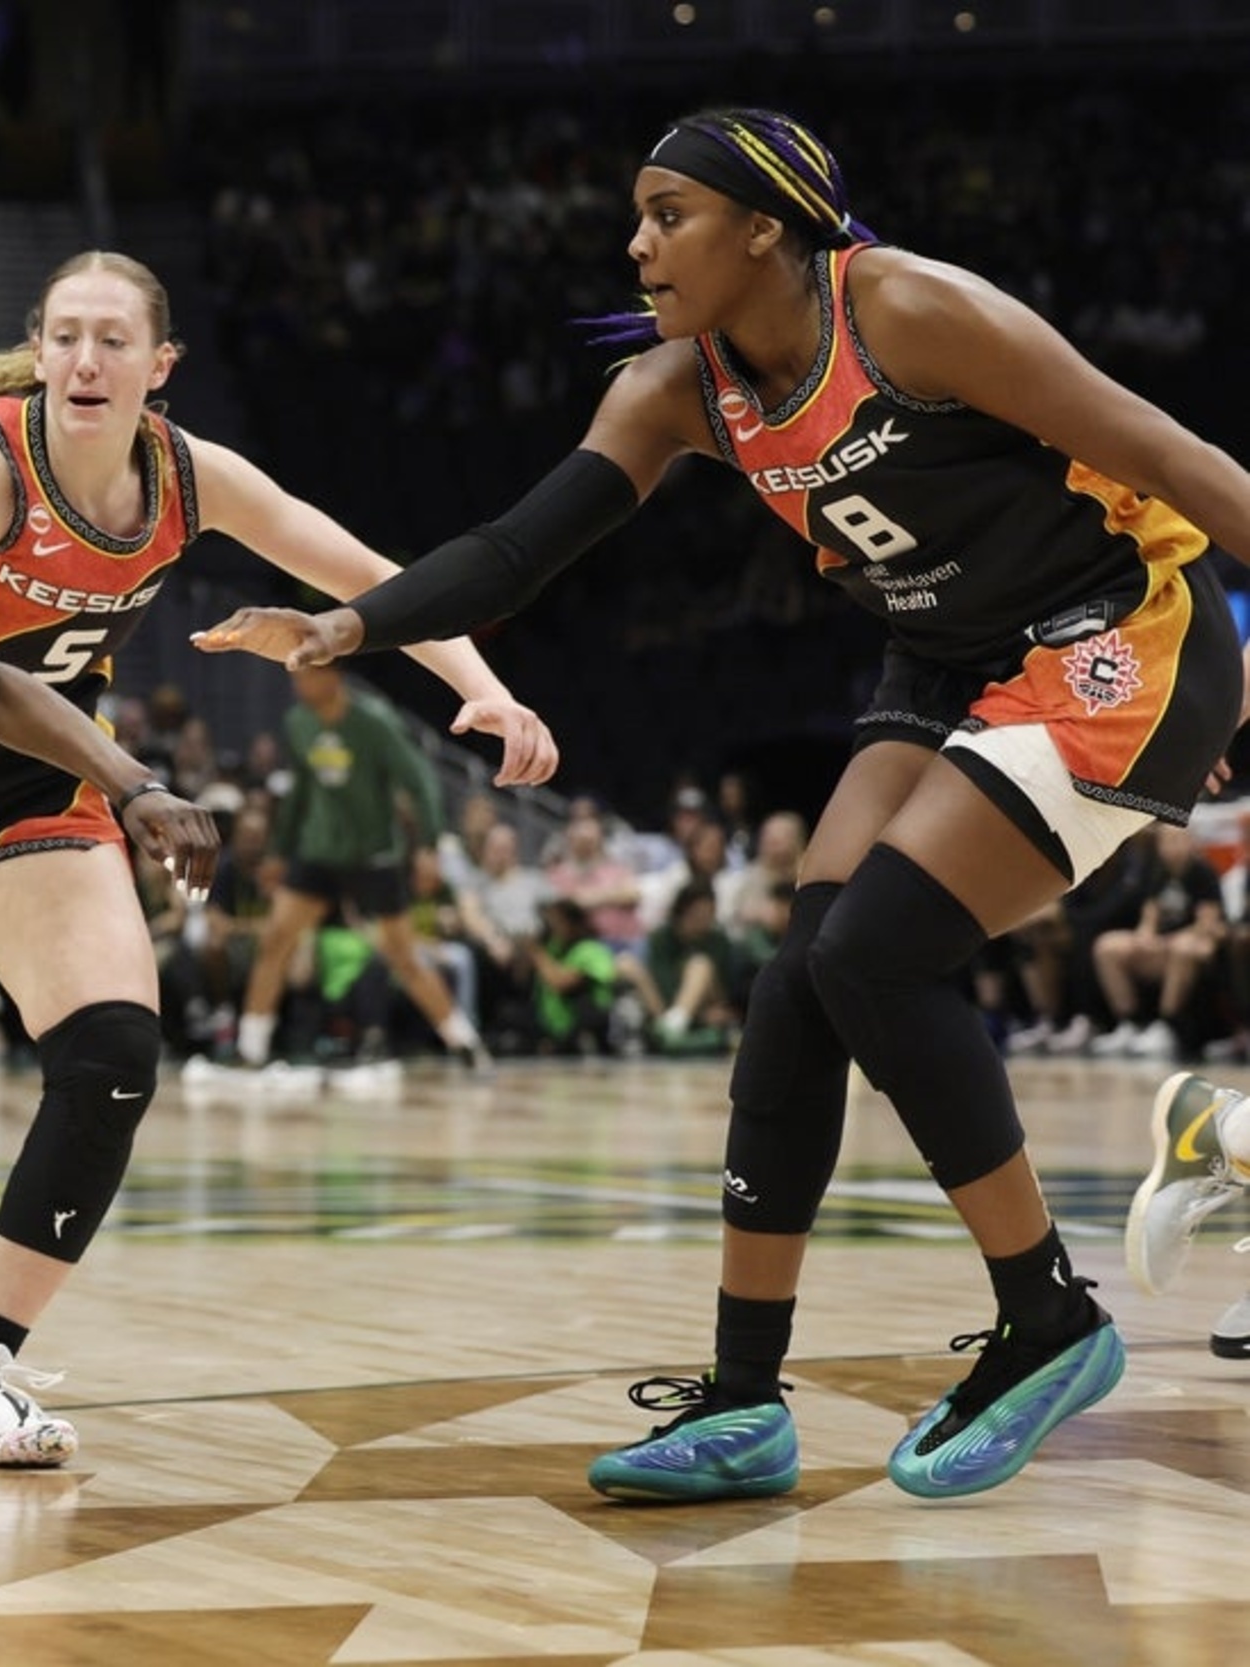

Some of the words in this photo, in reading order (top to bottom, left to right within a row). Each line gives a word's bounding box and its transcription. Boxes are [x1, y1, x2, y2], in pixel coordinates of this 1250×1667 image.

[821, 495, 918, 562] 8
[884, 589, 938, 612] Health
[31, 629, 108, 683] 5
[1090, 656, 1118, 684] C
